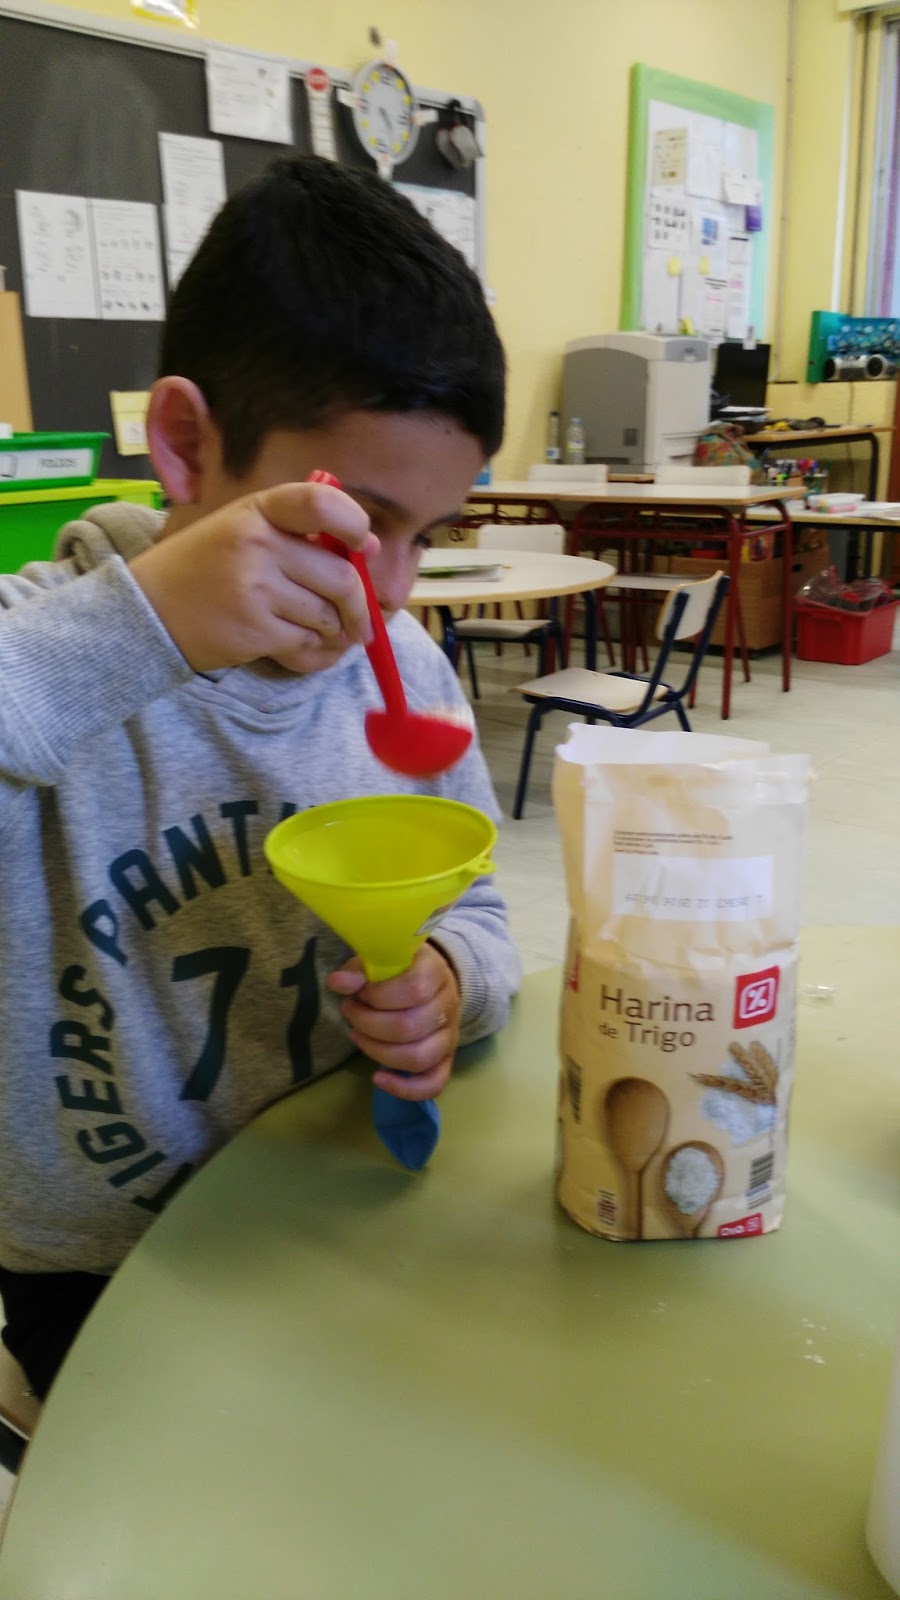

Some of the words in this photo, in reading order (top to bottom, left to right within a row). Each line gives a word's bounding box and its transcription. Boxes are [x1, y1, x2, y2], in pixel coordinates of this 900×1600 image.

[80, 800, 298, 966] PANT
[171, 936, 322, 1101] 71
[599, 1021, 619, 1039] de
[624, 1020, 697, 1053] Trigo
[600, 984, 715, 1022] Harina
